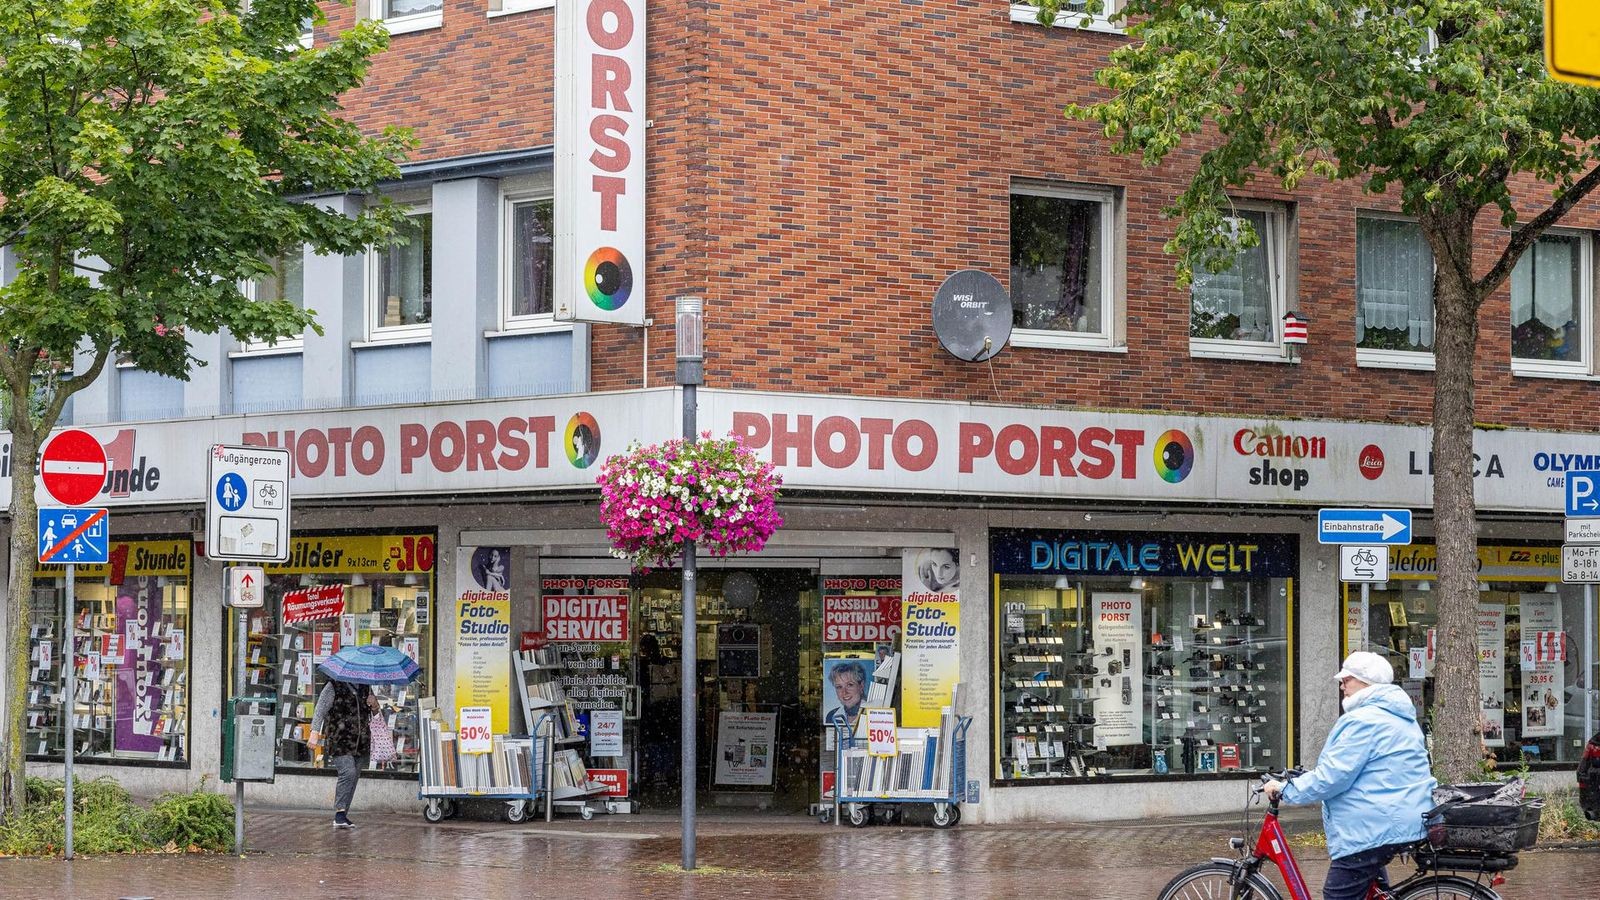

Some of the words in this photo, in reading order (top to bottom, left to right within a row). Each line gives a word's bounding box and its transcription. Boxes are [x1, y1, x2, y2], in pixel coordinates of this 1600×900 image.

[401, 415, 556, 474] PORST
[733, 411, 939, 473] PHOTO
[959, 422, 1145, 488] PORST
[1233, 428, 1327, 459] Canon
[1360, 456, 1383, 469] Leica
[1248, 459, 1309, 491] shop
[1547, 477, 1565, 488] CAME
[1572, 476, 1594, 511] P
[1324, 522, 1384, 531] Einbahnstraße
[1030, 540, 1161, 572] DIGITALE
[1175, 543, 1259, 573] WELT
[1572, 549, 1599, 557] Mo-Fr
[108, 544, 129, 586] 1
[134, 545, 185, 571] Stunde
[346, 557, 379, 568] 9x13cm
[383, 558, 391, 571] €
[543, 579, 584, 589] PHOTO
[587, 579, 629, 589] PORST
[824, 578, 867, 589] PHOTO
[869, 578, 902, 589] PORS
[287, 595, 340, 612] Räumungsverkauf
[307, 592, 320, 602] Total
[461, 589, 509, 604] digitales
[827, 598, 879, 610] PASSBILD
[908, 592, 955, 606] digitales
[460, 603, 499, 618] Foto-
[546, 598, 627, 618] DIGITAL-
[906, 604, 946, 620] Foto-
[1101, 601, 1132, 610] PHOTO
[827, 611, 886, 623] PORTRAIT-
[1101, 613, 1131, 622] PORST
[460, 620, 510, 635] Studio
[546, 620, 623, 640] SERVICE
[827, 624, 902, 640] STUDIO
[906, 621, 957, 637] Studio
[568, 661, 586, 669] vom
[587, 659, 605, 669] Bild
[1530, 675, 1548, 685] 39,95
[1548, 675, 1554, 683] €
[568, 686, 588, 698] allen
[590, 686, 627, 699] digitalen
[461, 726, 490, 741] 50%
[869, 729, 895, 744] 50%
[593, 774, 618, 782] zum
